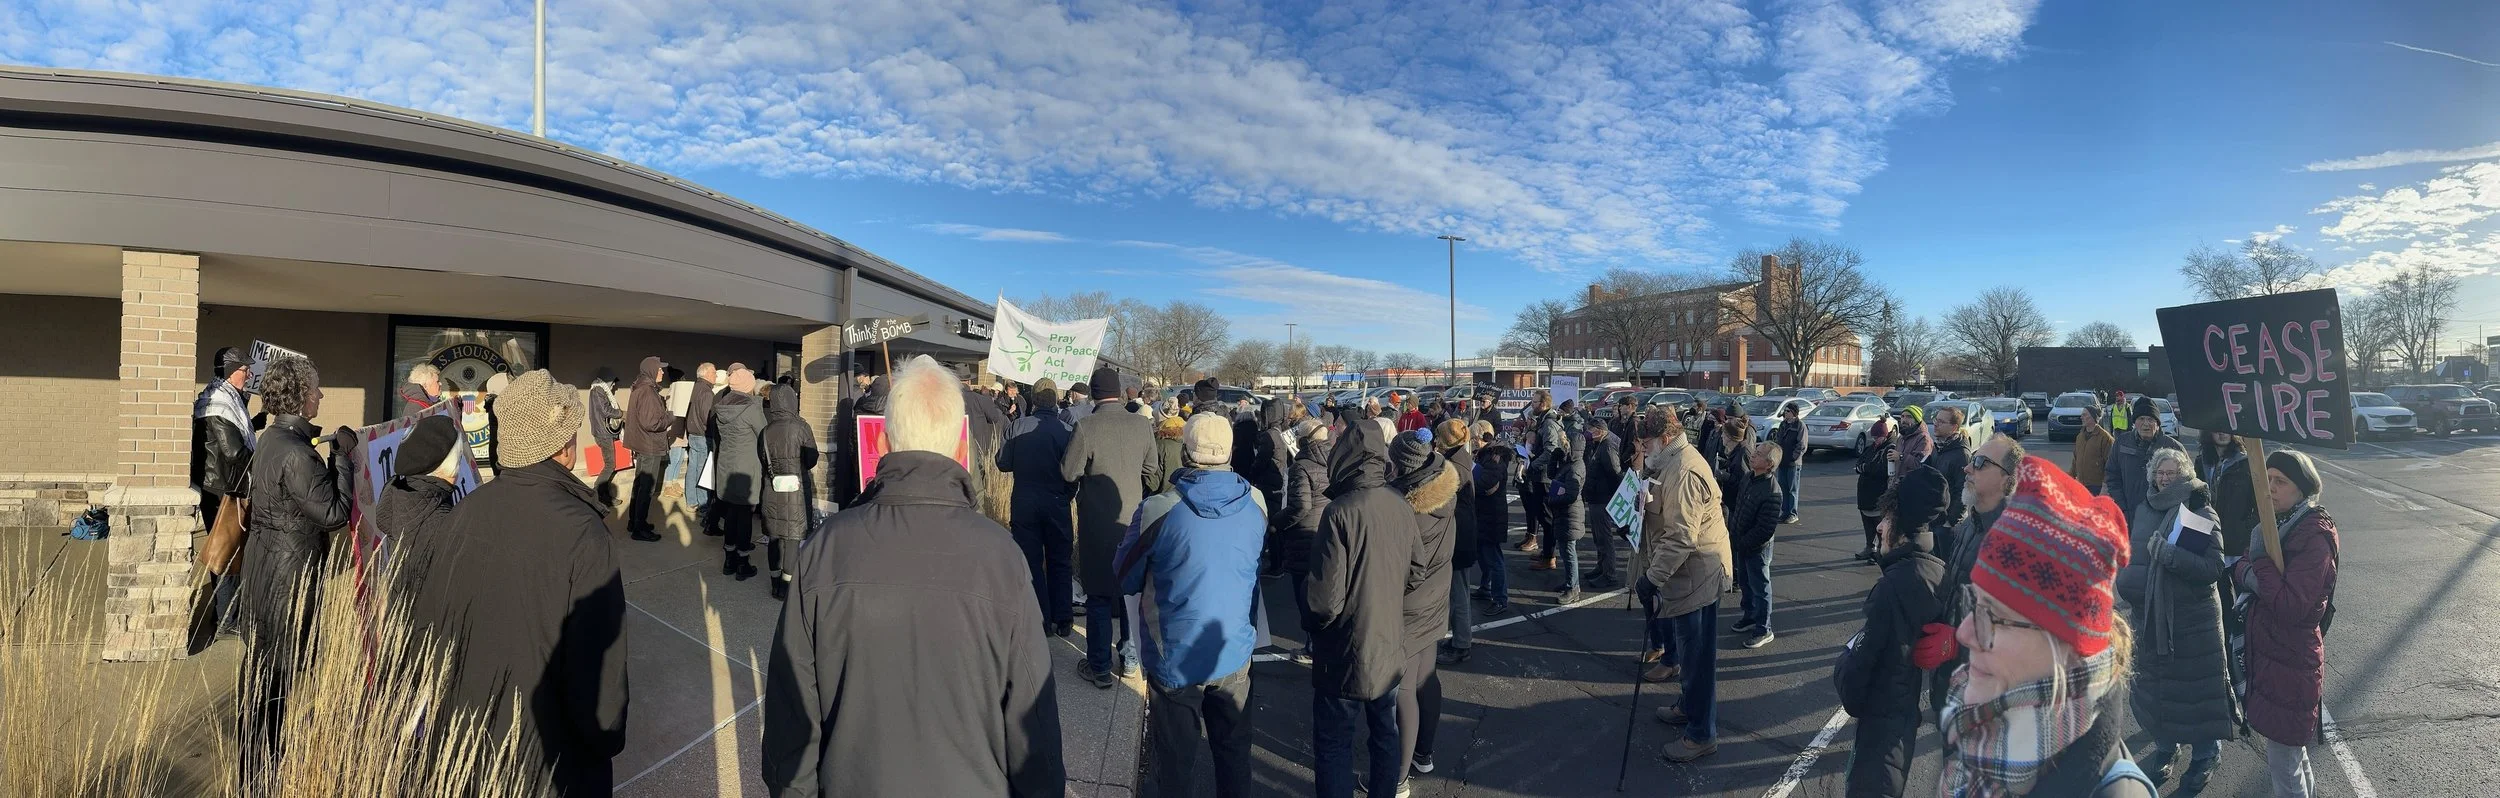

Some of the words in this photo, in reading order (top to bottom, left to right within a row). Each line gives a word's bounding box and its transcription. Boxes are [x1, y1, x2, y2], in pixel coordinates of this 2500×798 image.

[844, 324, 873, 345] Think
[880, 322, 912, 340] BOMB
[967, 318, 986, 337] Edward
[1050, 333, 1077, 344] Pray
[452, 344, 499, 366] HOUSE
[1047, 344, 1063, 354] for
[1064, 345, 1098, 357] Peace
[2203, 319, 2337, 384] CEASE
[1044, 355, 1065, 368] Act
[1043, 370, 1058, 380] for
[2221, 380, 2335, 440] FIRE
